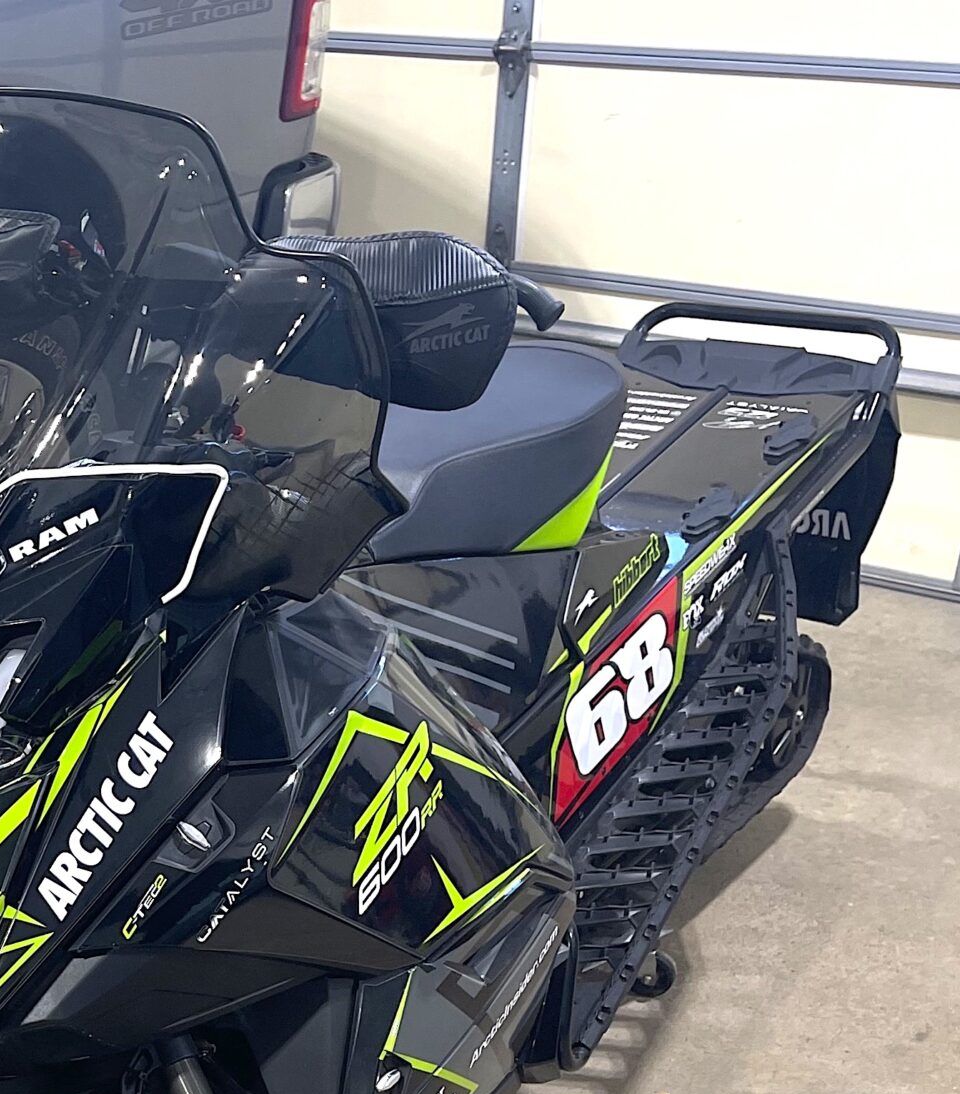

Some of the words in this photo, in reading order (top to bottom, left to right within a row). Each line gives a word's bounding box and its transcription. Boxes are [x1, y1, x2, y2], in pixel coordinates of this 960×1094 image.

[125, 13, 185, 37] OFF
[191, 0, 269, 23] ROAD
[409, 330, 463, 354] ARCTIC
[464, 324, 490, 344] CAT
[8, 507, 100, 563] RAM
[613, 532, 661, 608] hibbert
[565, 612, 674, 776] 68
[37, 777, 136, 922] ARCTIC
[117, 710, 174, 789] CAT
[352, 720, 434, 888] ZR
[121, 873, 168, 940] C-TEC2
[196, 826, 276, 943] CATALYST
